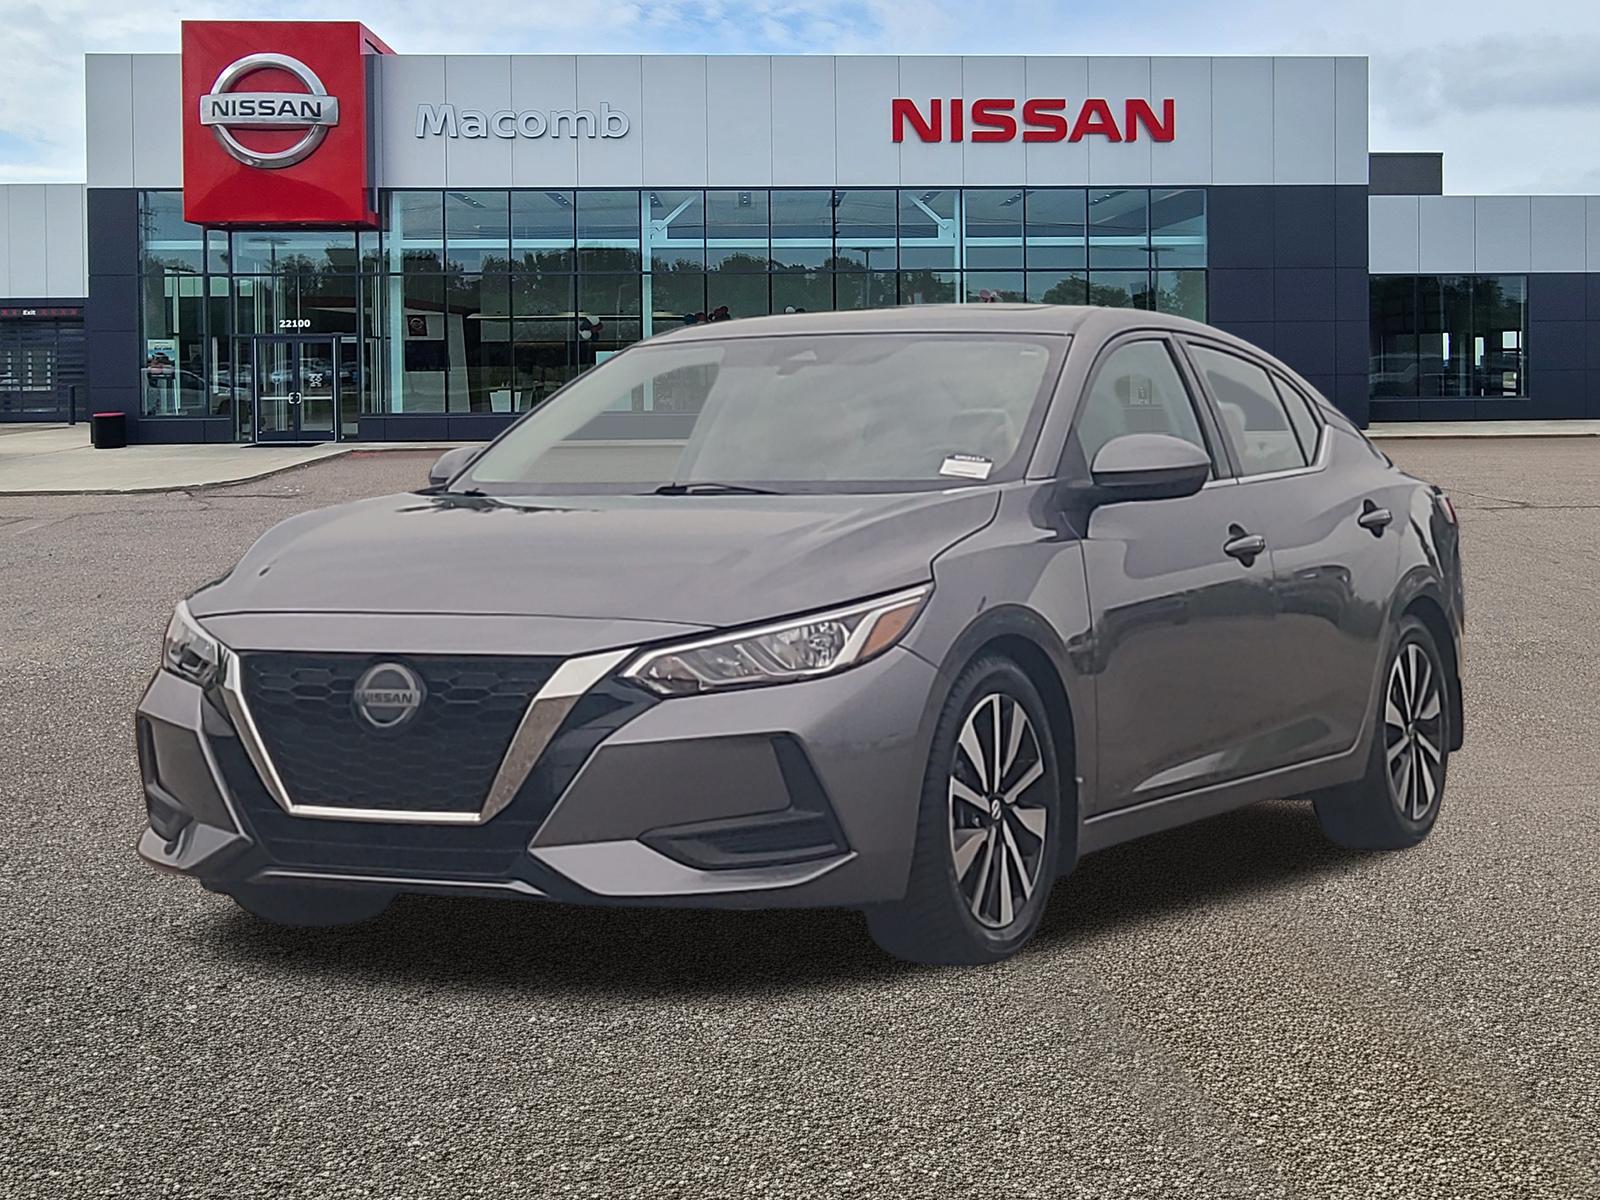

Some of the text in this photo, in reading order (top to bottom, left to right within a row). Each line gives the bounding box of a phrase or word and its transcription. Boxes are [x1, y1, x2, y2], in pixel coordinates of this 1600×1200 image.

[212, 100, 322, 118] NISSAN
[415, 102, 630, 138] Macomb
[892, 98, 1176, 142] NISSAN
[279, 319, 311, 328] 22100
